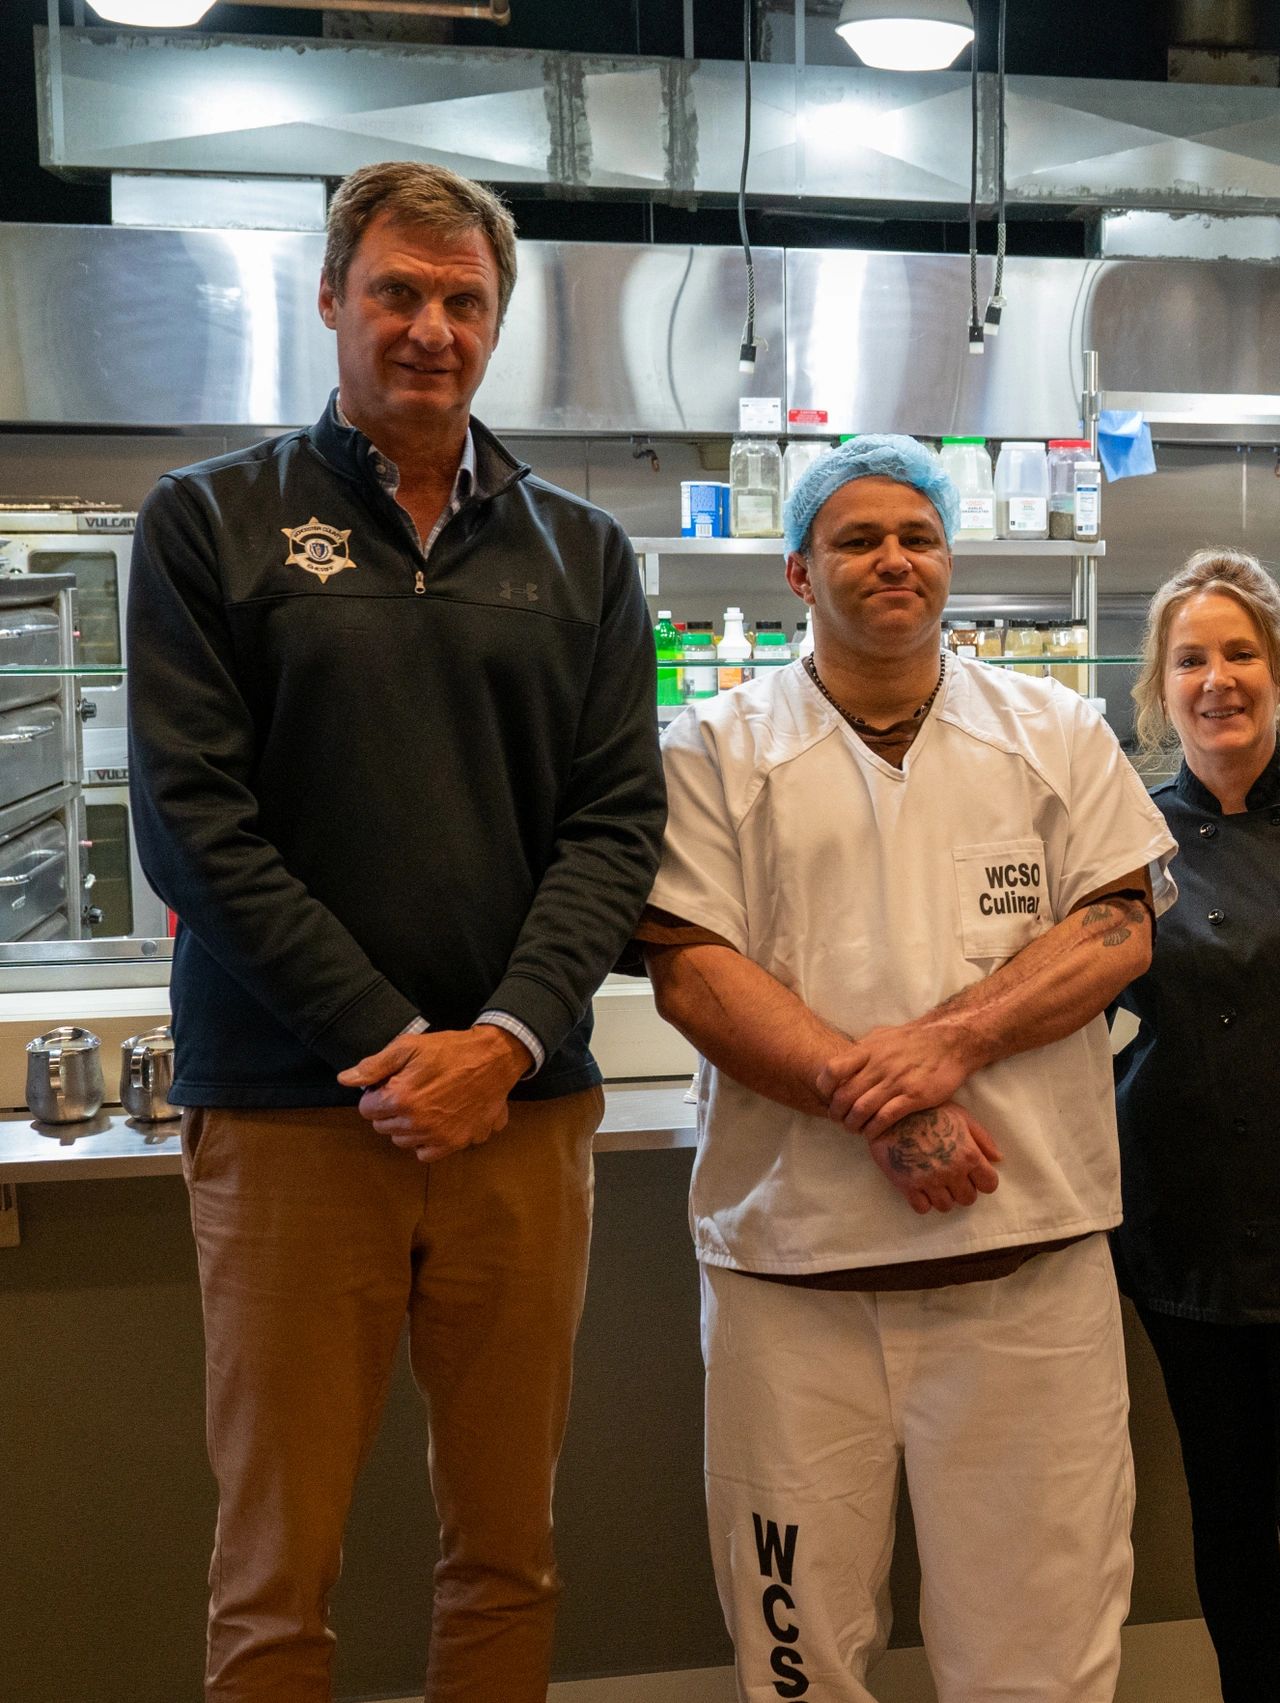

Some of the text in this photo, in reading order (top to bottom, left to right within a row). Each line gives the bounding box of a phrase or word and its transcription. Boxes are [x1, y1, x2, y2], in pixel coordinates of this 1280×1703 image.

[85, 517, 136, 528] VULCAN
[96, 769, 129, 780] VULC
[984, 863, 1040, 889] WCSO
[979, 890, 1041, 920] Culinar
[752, 1511, 810, 1703] WCS
